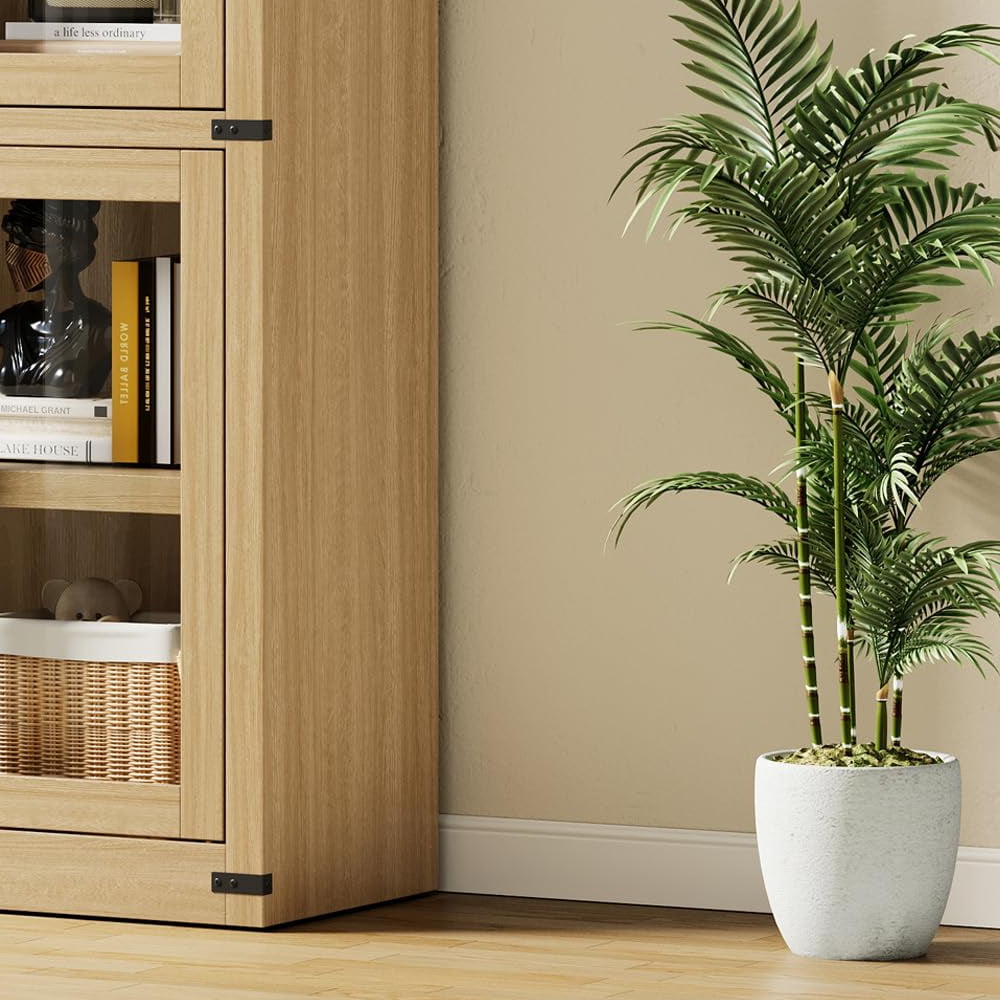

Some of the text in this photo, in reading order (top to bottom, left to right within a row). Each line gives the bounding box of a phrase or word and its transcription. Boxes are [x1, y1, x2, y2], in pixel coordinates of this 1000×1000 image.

[53, 26, 146, 41] a life less ordinary
[0, 404, 72, 416] MICHAEL GRANT
[33, 443, 79, 457] HOUSE
